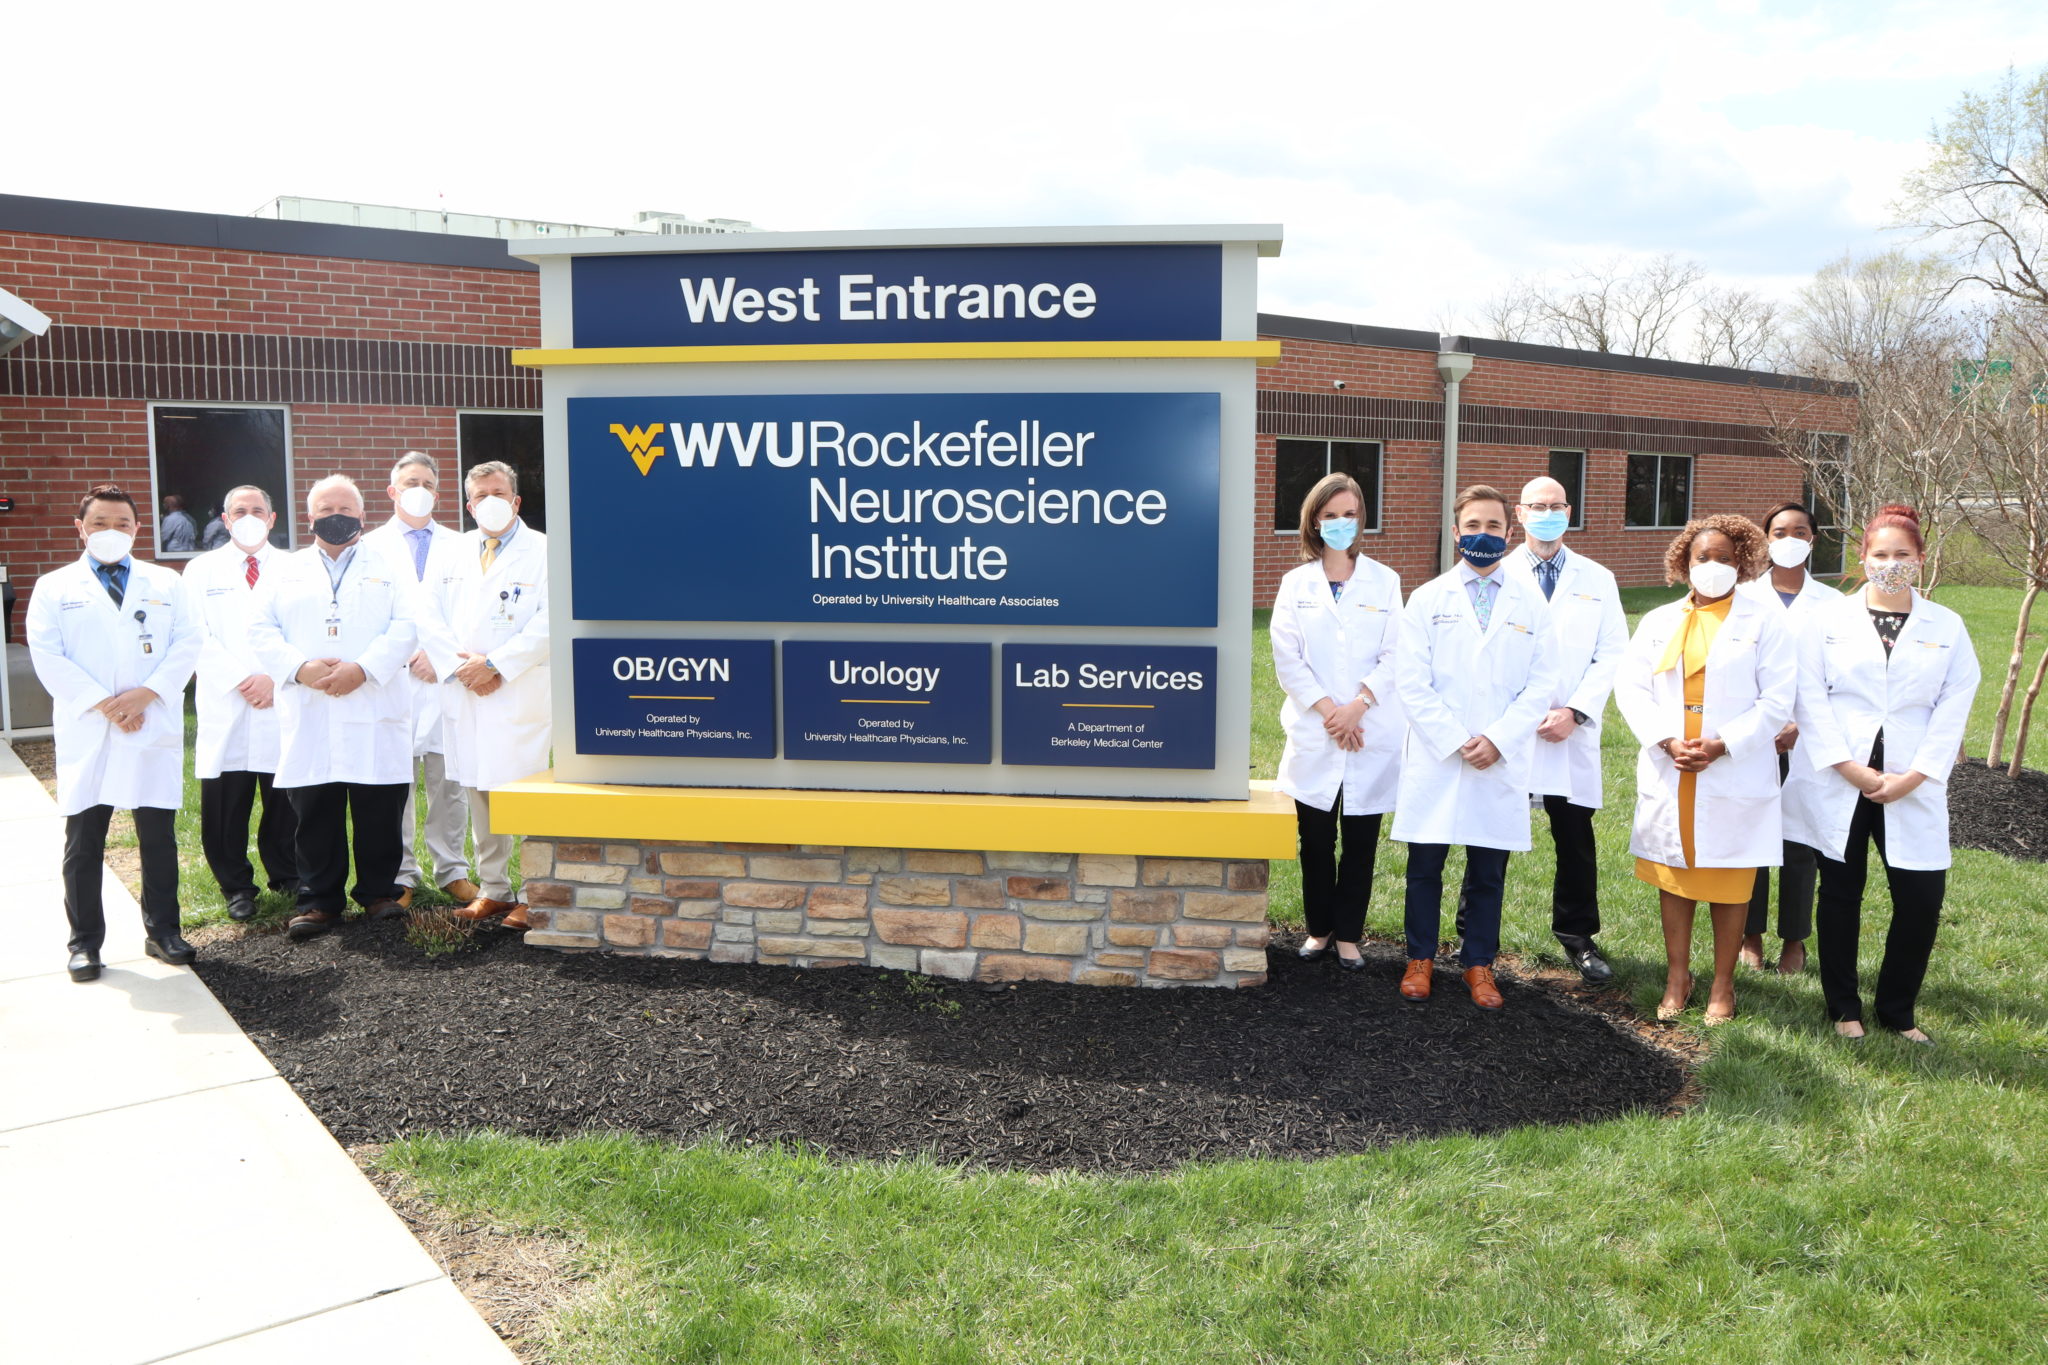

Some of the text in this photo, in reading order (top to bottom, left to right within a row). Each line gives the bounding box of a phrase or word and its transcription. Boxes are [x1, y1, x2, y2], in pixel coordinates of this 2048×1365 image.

[679, 274, 1097, 323] West Entrance
[810, 477, 1167, 525] Neuroscience
[811, 533, 1008, 581] Institute
[812, 594, 1060, 608] Operated by University Healthcare Associates
[612, 656, 730, 683] OB/GYN
[829, 660, 940, 692] Urology
[1016, 662, 1203, 691] Lab Services
[646, 713, 701, 725] Operated by
[858, 718, 915, 731] Operated by
[595, 727, 753, 740] University Healthcare Physicians, Inc.
[1067, 722, 1145, 734] A Department of
[804, 732, 969, 745] University Healthcare Physicians, Inc.
[1051, 736, 1164, 749] Berkeley Medical Center
